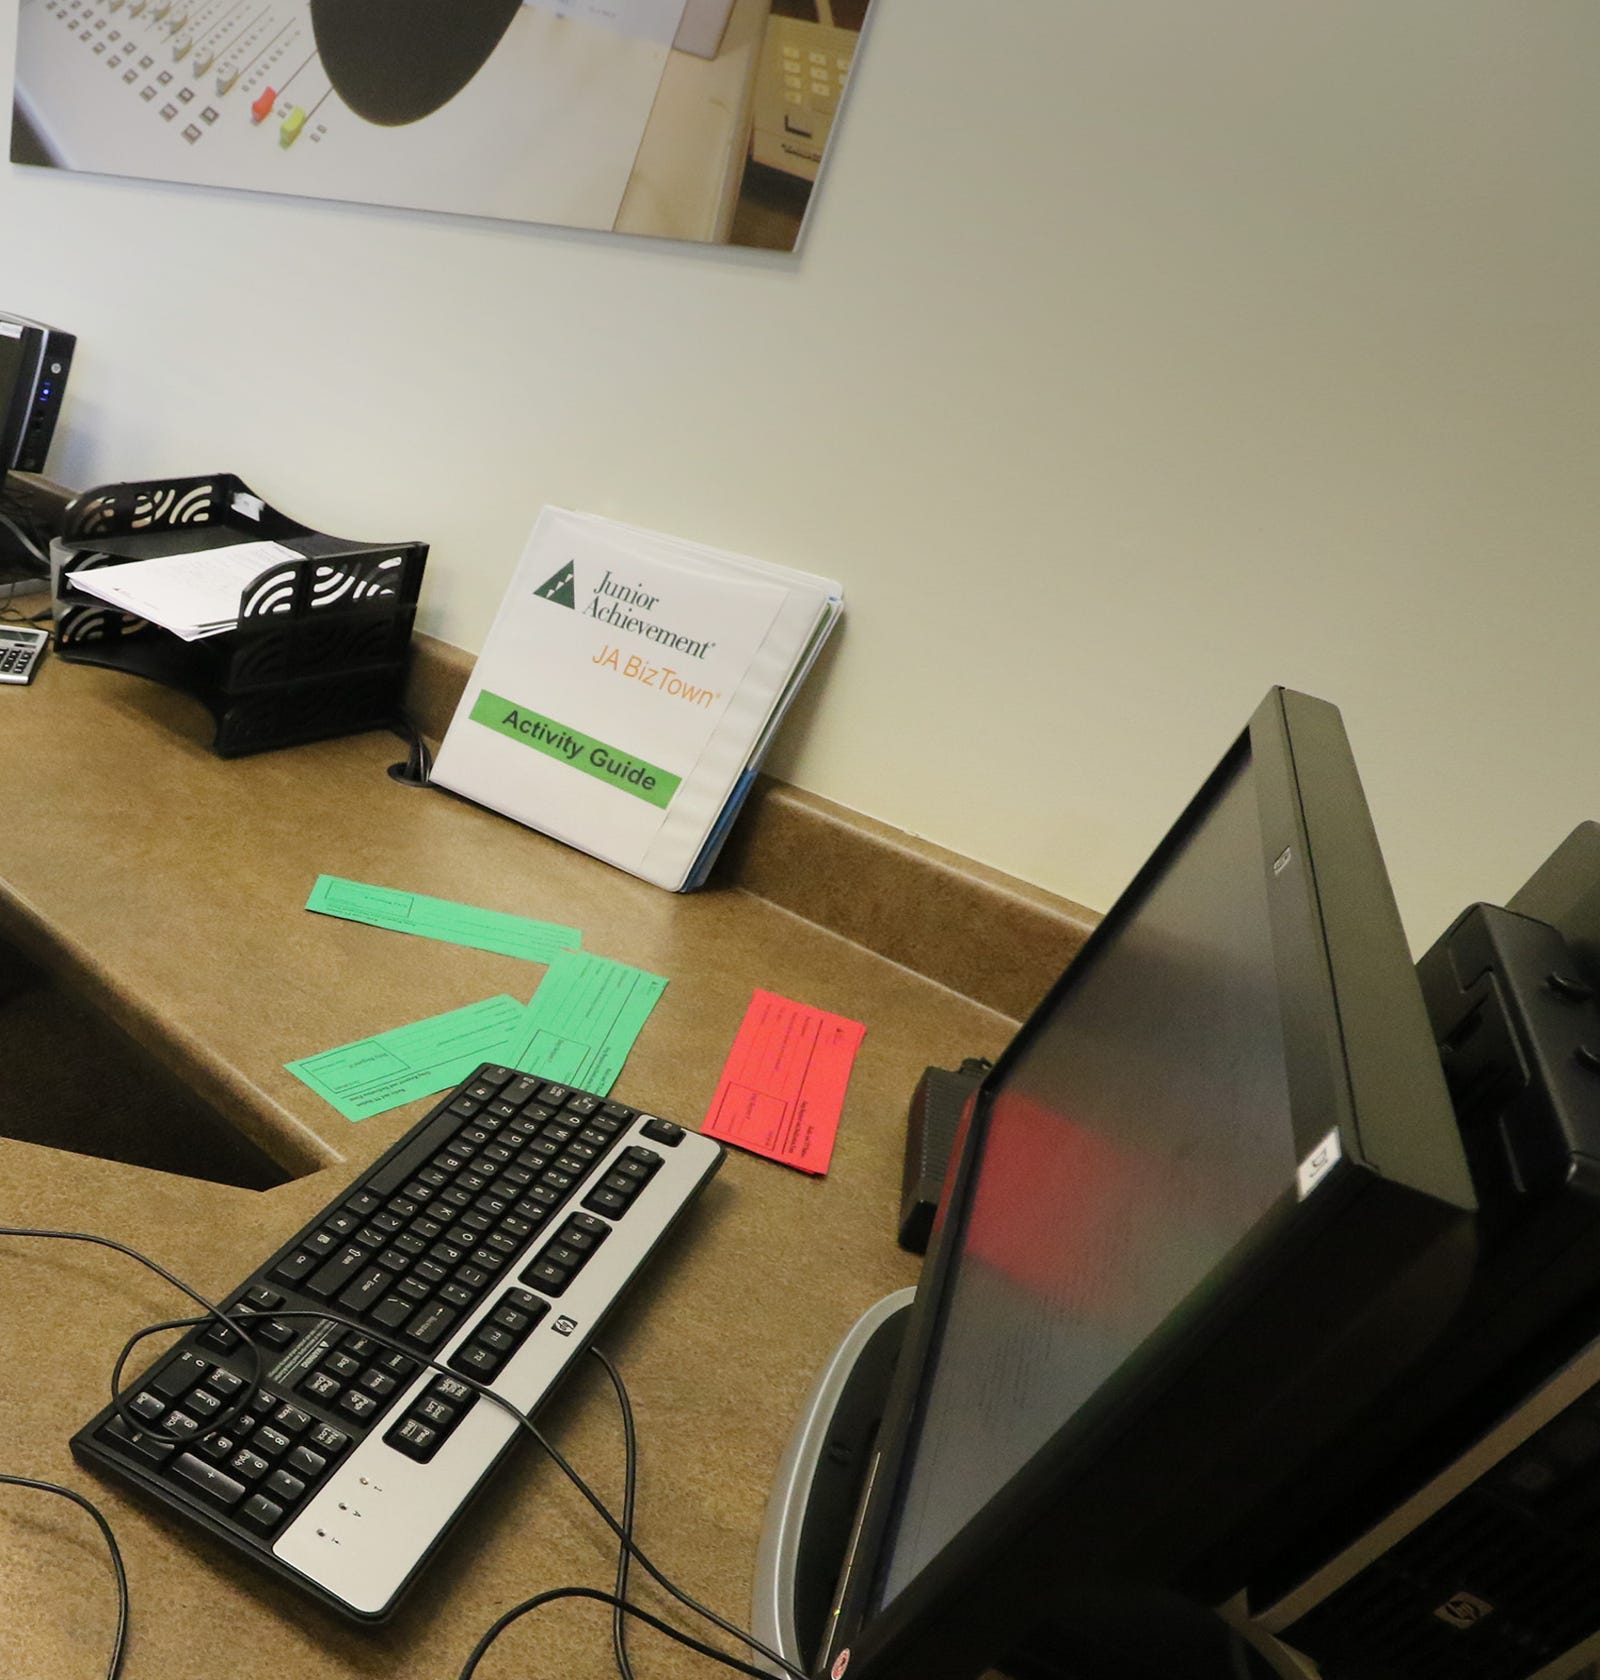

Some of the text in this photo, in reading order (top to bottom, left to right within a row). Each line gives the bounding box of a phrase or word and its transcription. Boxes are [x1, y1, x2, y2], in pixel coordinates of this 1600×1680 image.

[594, 570, 660, 611] Junior
[583, 596, 713, 659] Achievement
[592, 645, 714, 708] JA BizTown
[503, 710, 656, 790] Activity Guide
